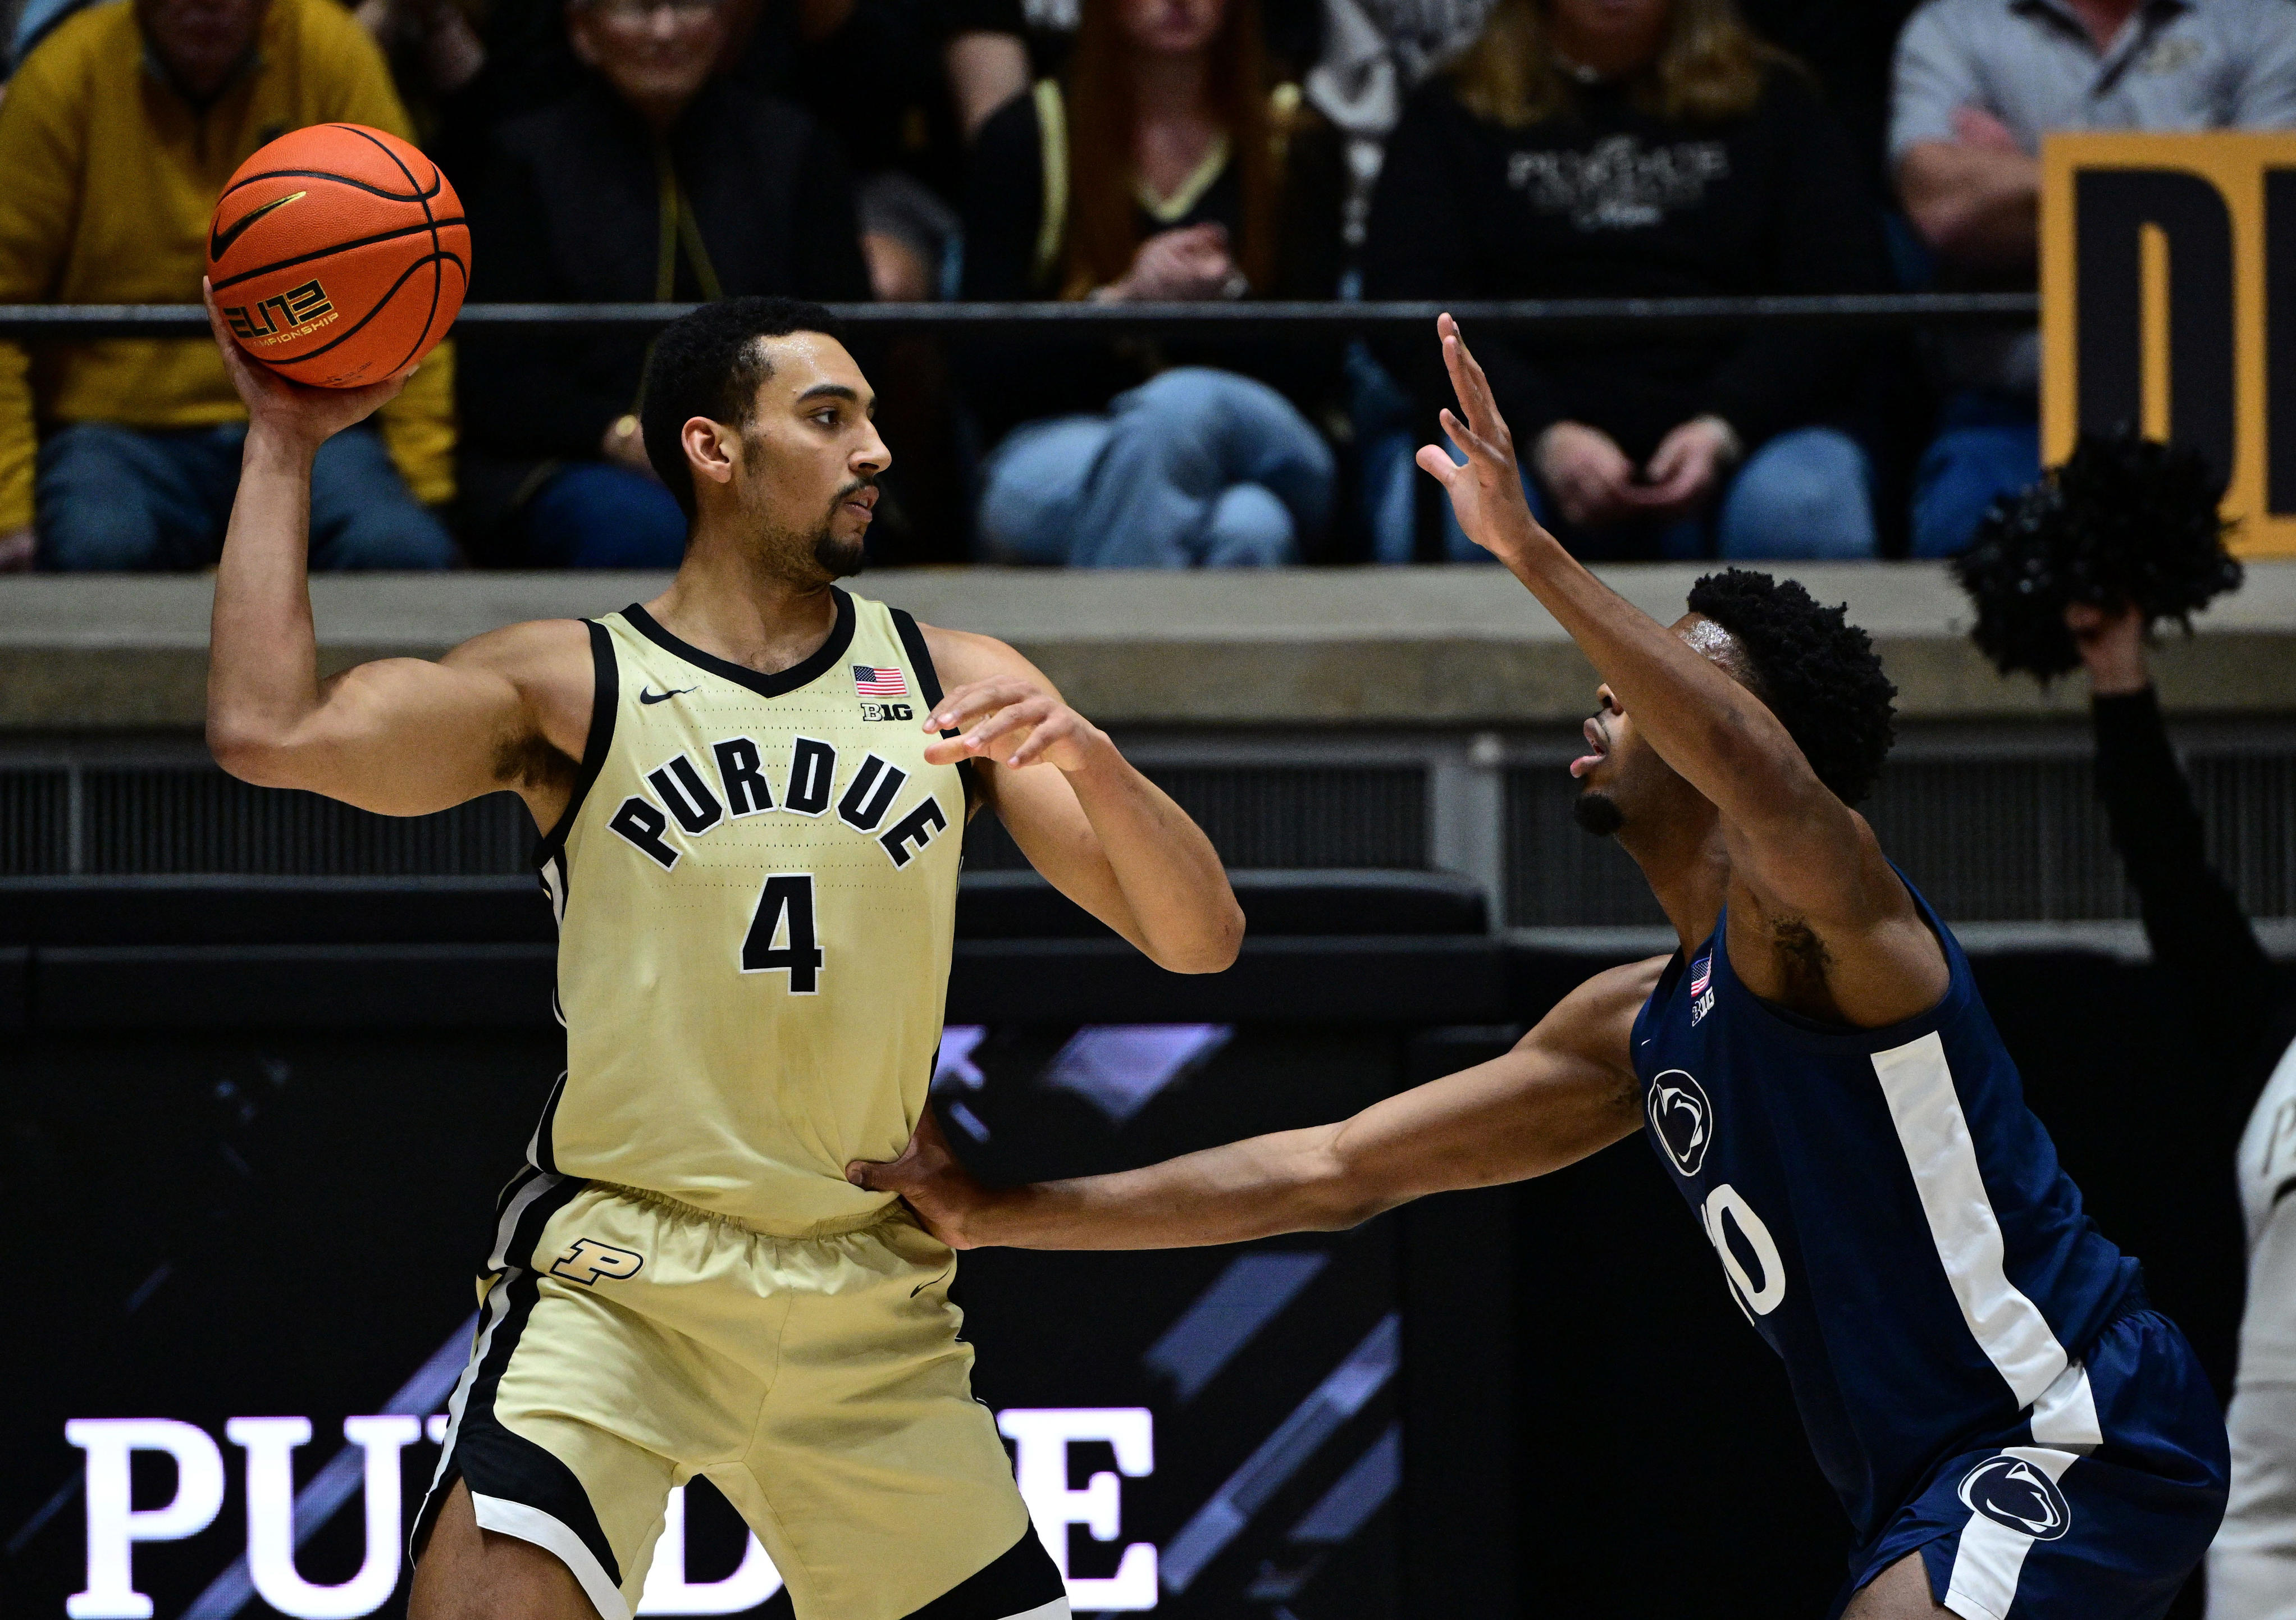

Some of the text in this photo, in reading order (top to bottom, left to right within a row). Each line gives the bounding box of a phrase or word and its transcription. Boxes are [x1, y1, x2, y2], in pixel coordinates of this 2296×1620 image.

[605, 734, 950, 872] PURDUE
[740, 873, 825, 996] 4
[549, 1238, 643, 1286] P
